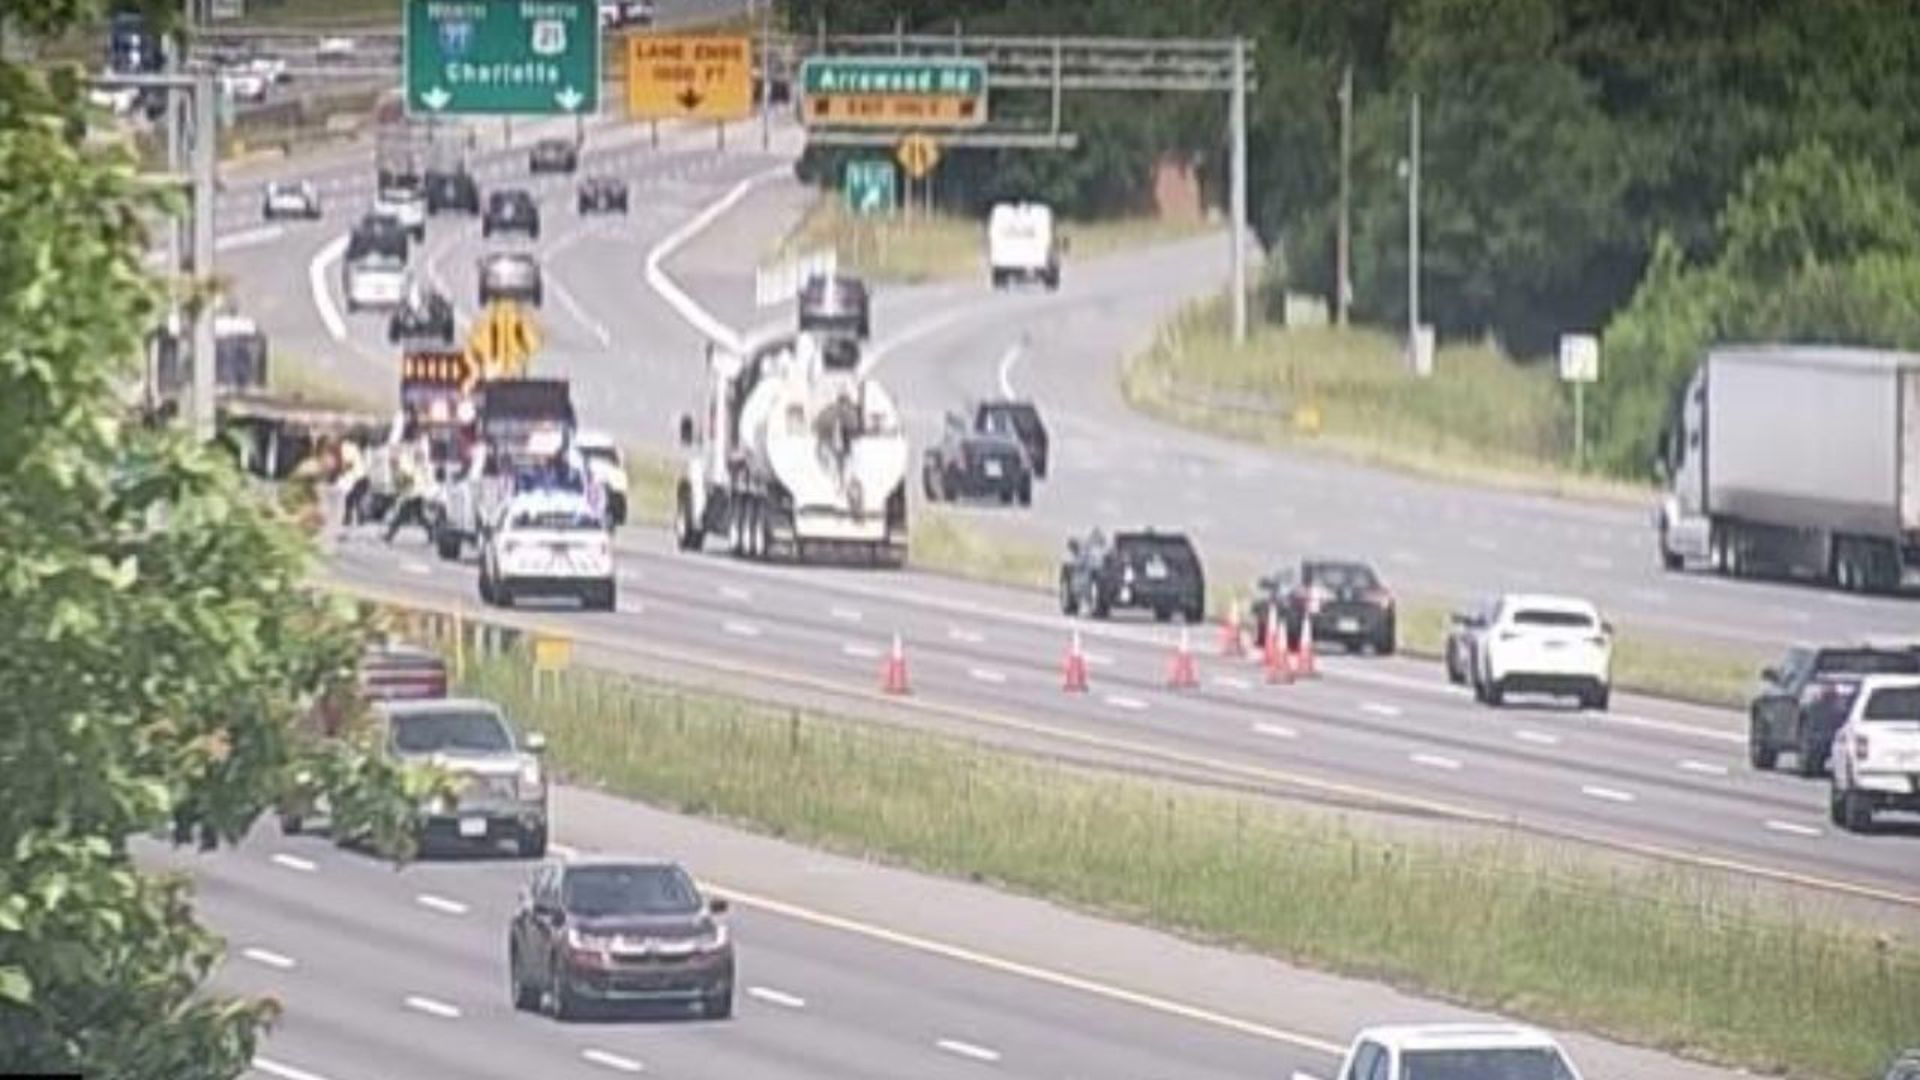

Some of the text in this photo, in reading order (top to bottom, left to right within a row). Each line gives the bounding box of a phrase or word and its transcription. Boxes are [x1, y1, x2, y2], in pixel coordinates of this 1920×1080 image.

[539, 24, 560, 47] 21
[637, 42, 682, 60] LANE
[446, 62, 559, 84] Charlotte
[705, 66, 726, 83] FT
[820, 67, 971, 93] Arrowood Rd
